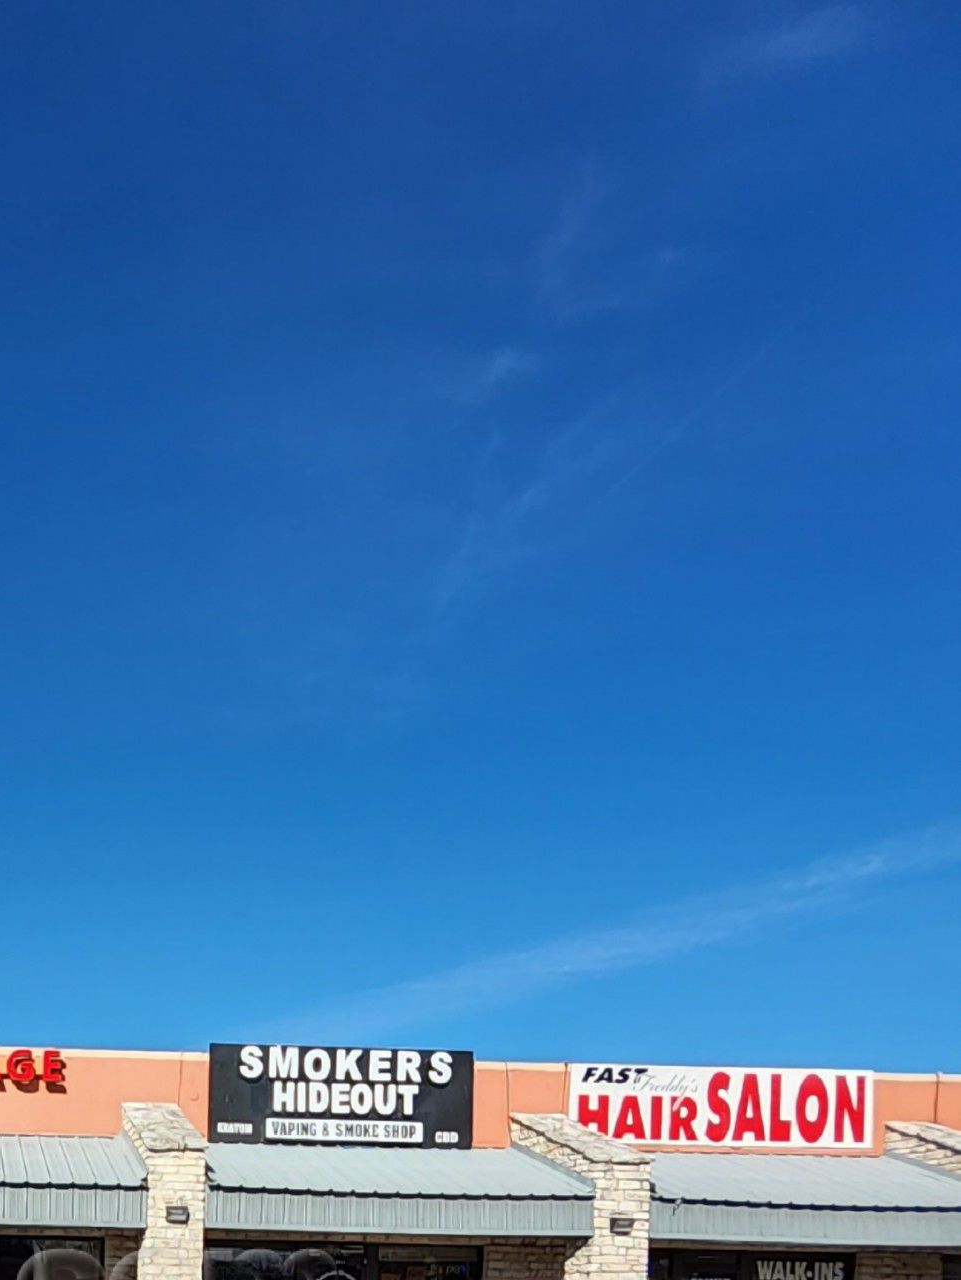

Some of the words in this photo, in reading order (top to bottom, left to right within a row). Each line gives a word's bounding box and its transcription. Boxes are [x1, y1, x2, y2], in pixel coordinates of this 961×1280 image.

[238, 1045, 453, 1084] SMOKERS
[581, 1067, 648, 1084] FAST
[272, 1081, 419, 1116] HIDEOUT
[578, 1095, 698, 1141] HAIR
[705, 1071, 866, 1144] SALON
[271, 1121, 317, 1137] VAPING
[321, 1123, 330, 1137] &
[335, 1123, 380, 1139] SMOKE
[384, 1124, 417, 1140] SHOP
